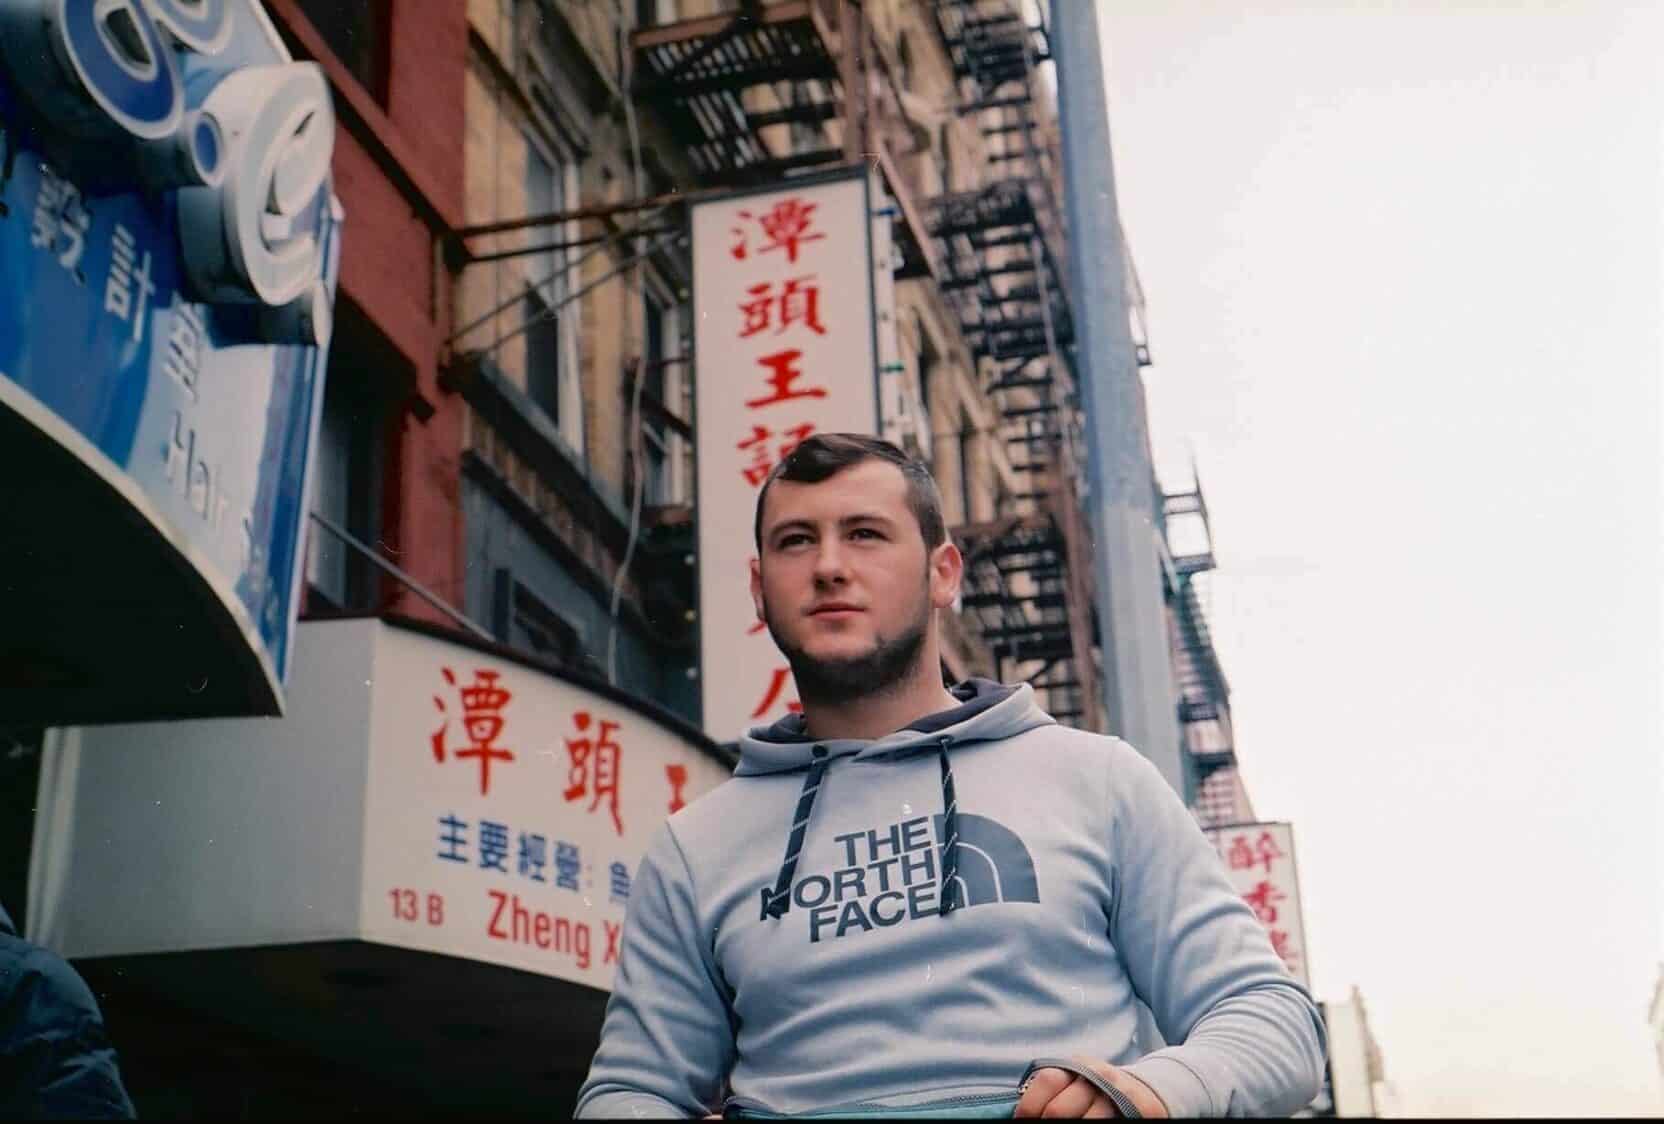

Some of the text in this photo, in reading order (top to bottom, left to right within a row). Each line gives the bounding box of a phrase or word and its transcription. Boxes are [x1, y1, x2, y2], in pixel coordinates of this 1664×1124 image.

[834, 816, 931, 866] THE
[389, 887, 418, 921] 13
[427, 893, 444, 926] B
[486, 889, 592, 971] Zheng
[810, 881, 942, 943] FACE
